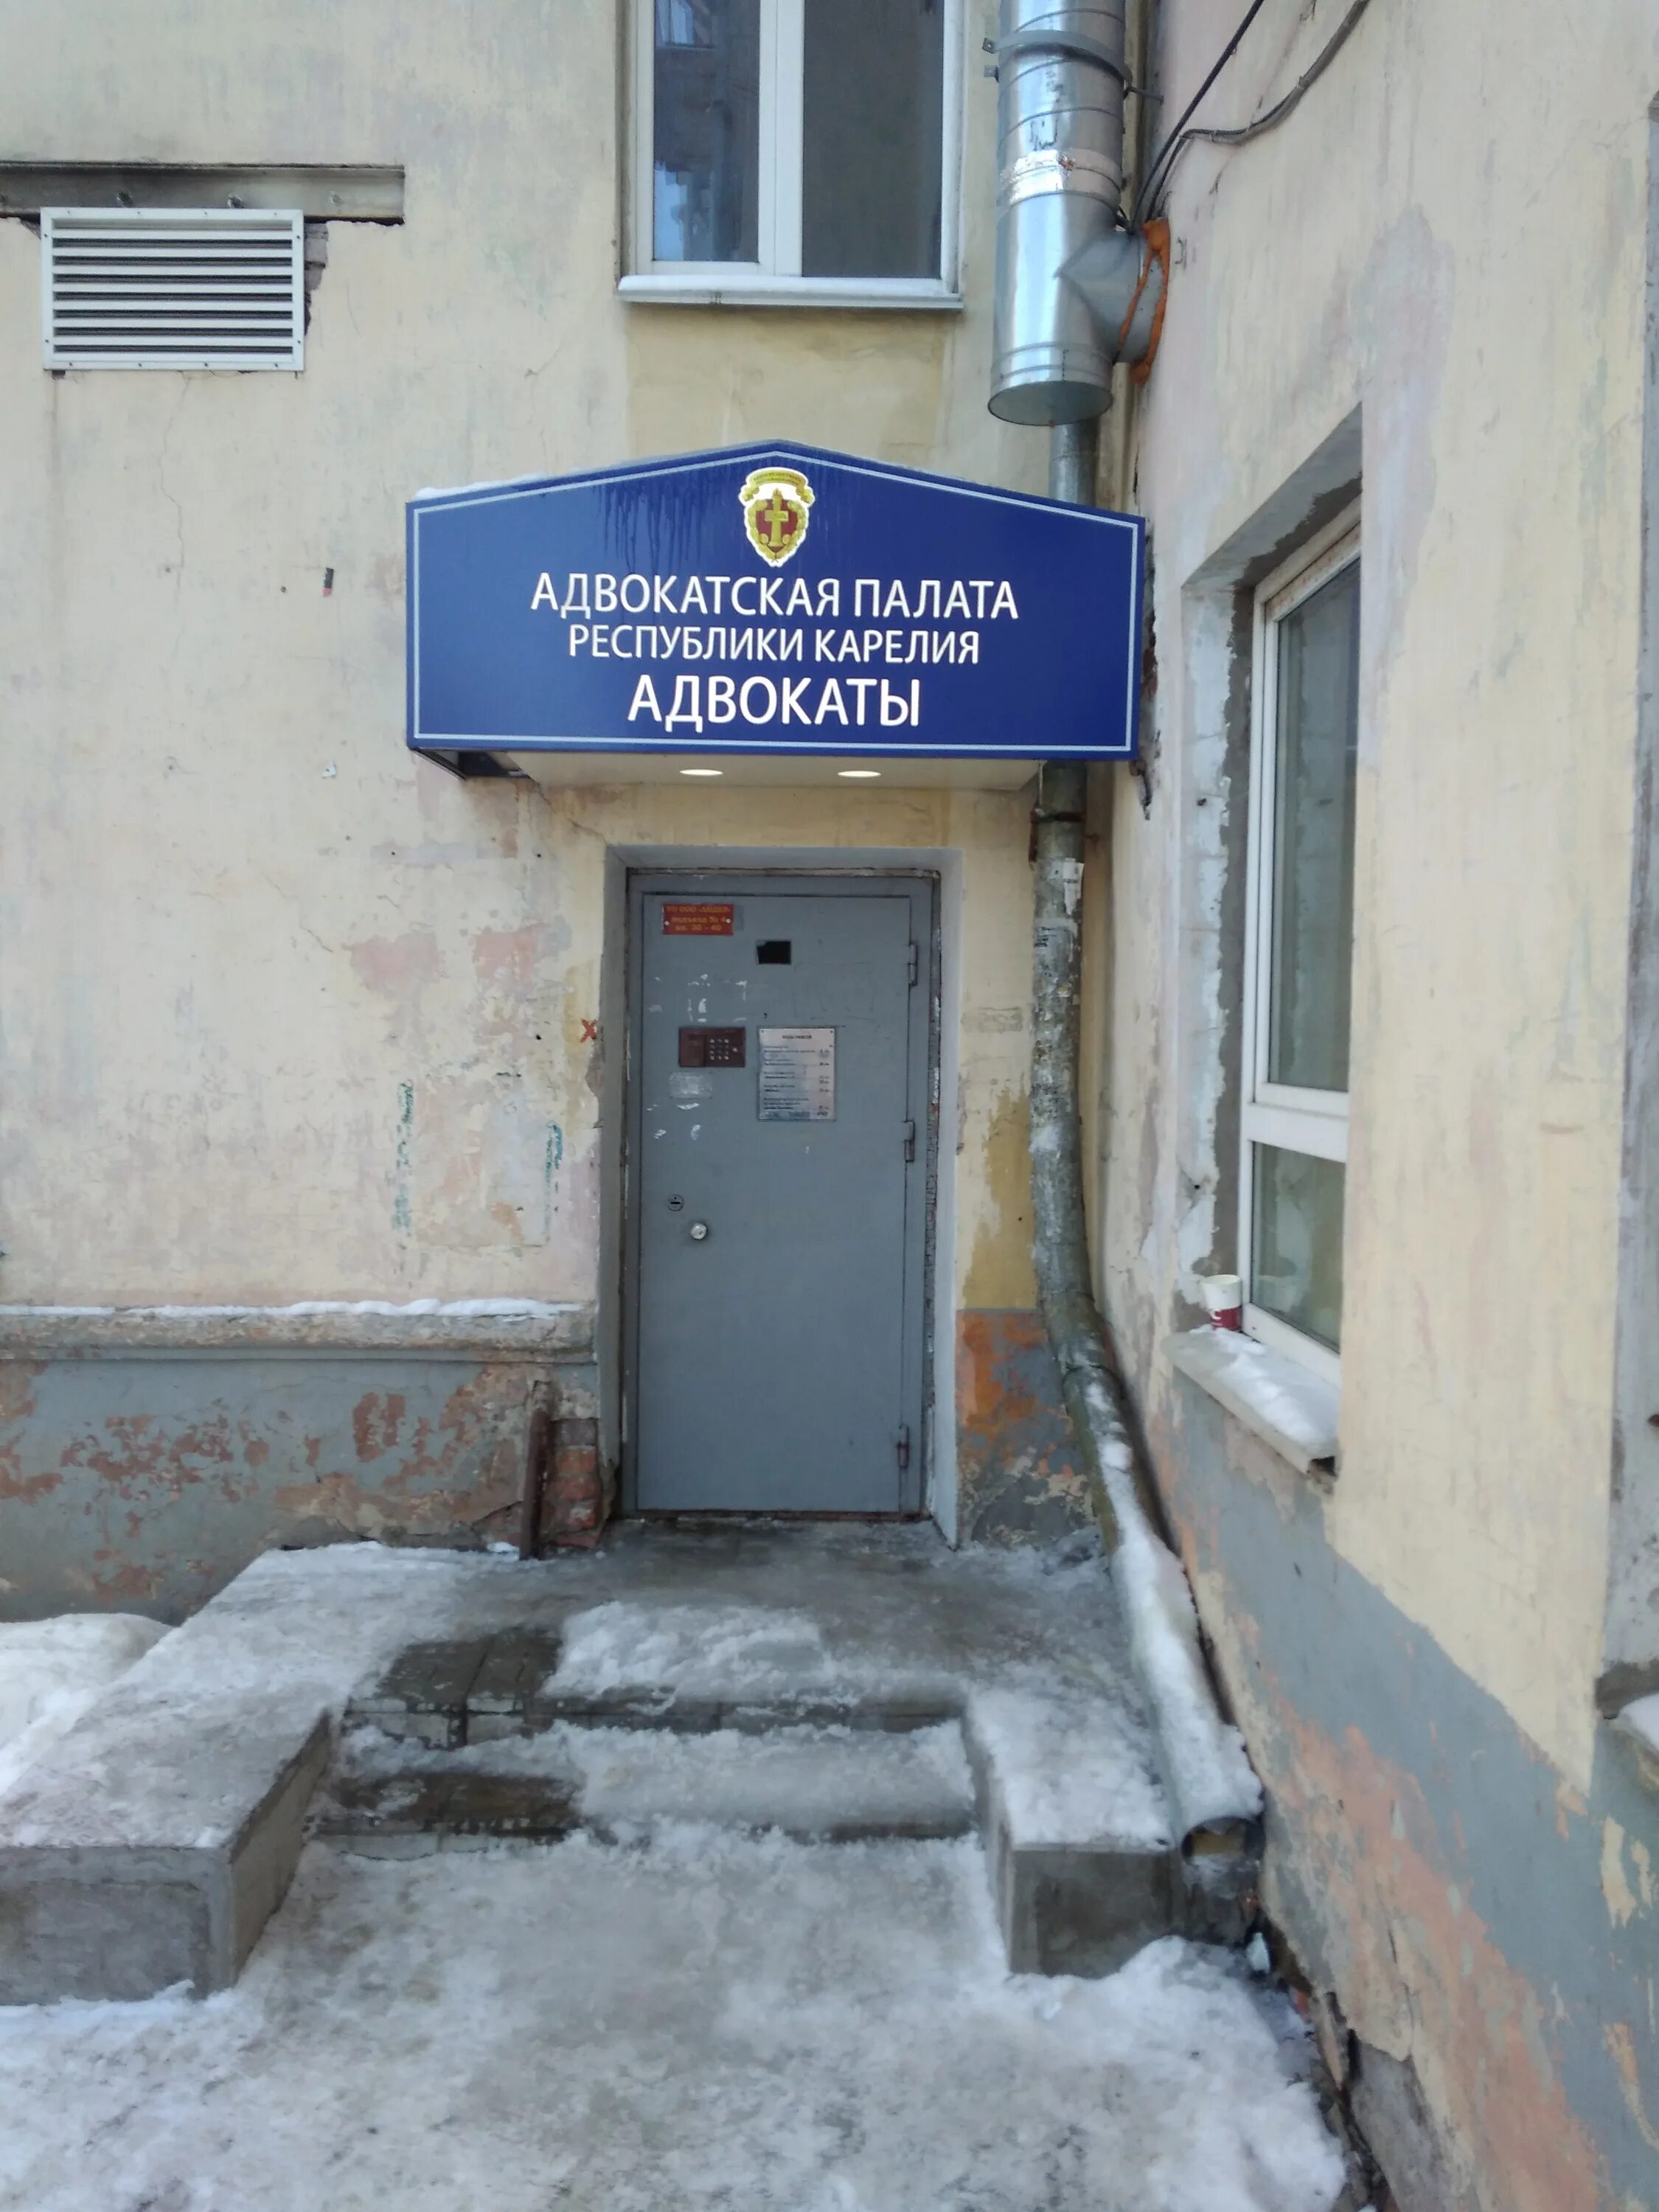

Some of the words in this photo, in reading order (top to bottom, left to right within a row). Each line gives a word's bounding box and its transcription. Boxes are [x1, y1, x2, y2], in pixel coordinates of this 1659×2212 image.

[531, 572, 840, 619] АДВОКАТСКАЯ
[854, 580, 1019, 619] ПАЛАТА
[569, 624, 803, 661] РЕСПУБЛИКИ
[815, 629, 979, 664] КАРЕЛИЯ
[627, 675, 920, 733] АДВОКАТЫ
